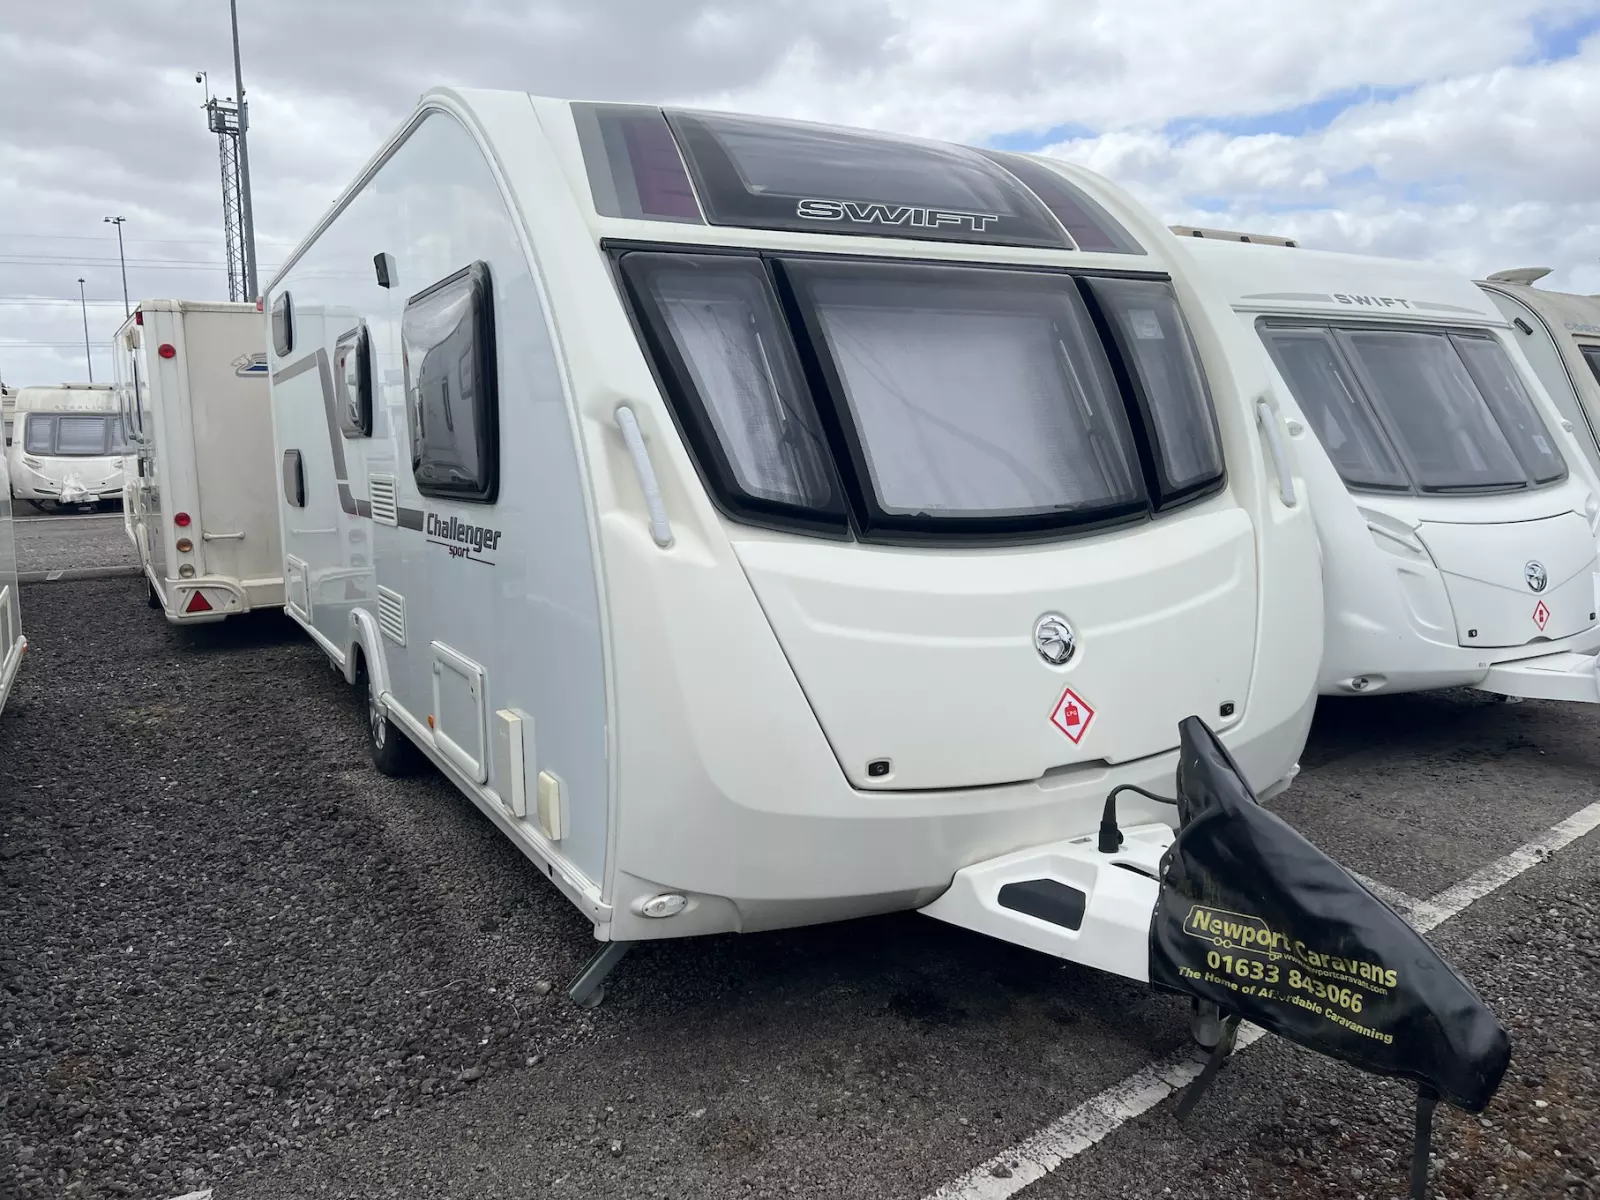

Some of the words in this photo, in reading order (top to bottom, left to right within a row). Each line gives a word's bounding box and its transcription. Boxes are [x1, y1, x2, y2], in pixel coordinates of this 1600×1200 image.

[797, 199, 998, 232] SWIFT
[1333, 293, 1410, 309] SWIFT
[426, 512, 502, 553] Challenger
[448, 546, 470, 558] sport
[1191, 910, 1291, 951] Newport
[1294, 940, 1398, 988] Caravans
[1207, 950, 1280, 983] 01633
[1288, 969, 1363, 1013] 843066
[1178, 966, 1202, 979] The
[1204, 972, 1239, 991] Home
[1241, 985, 1257, 995] of
[1324, 1008, 1394, 1045] Caravanning
